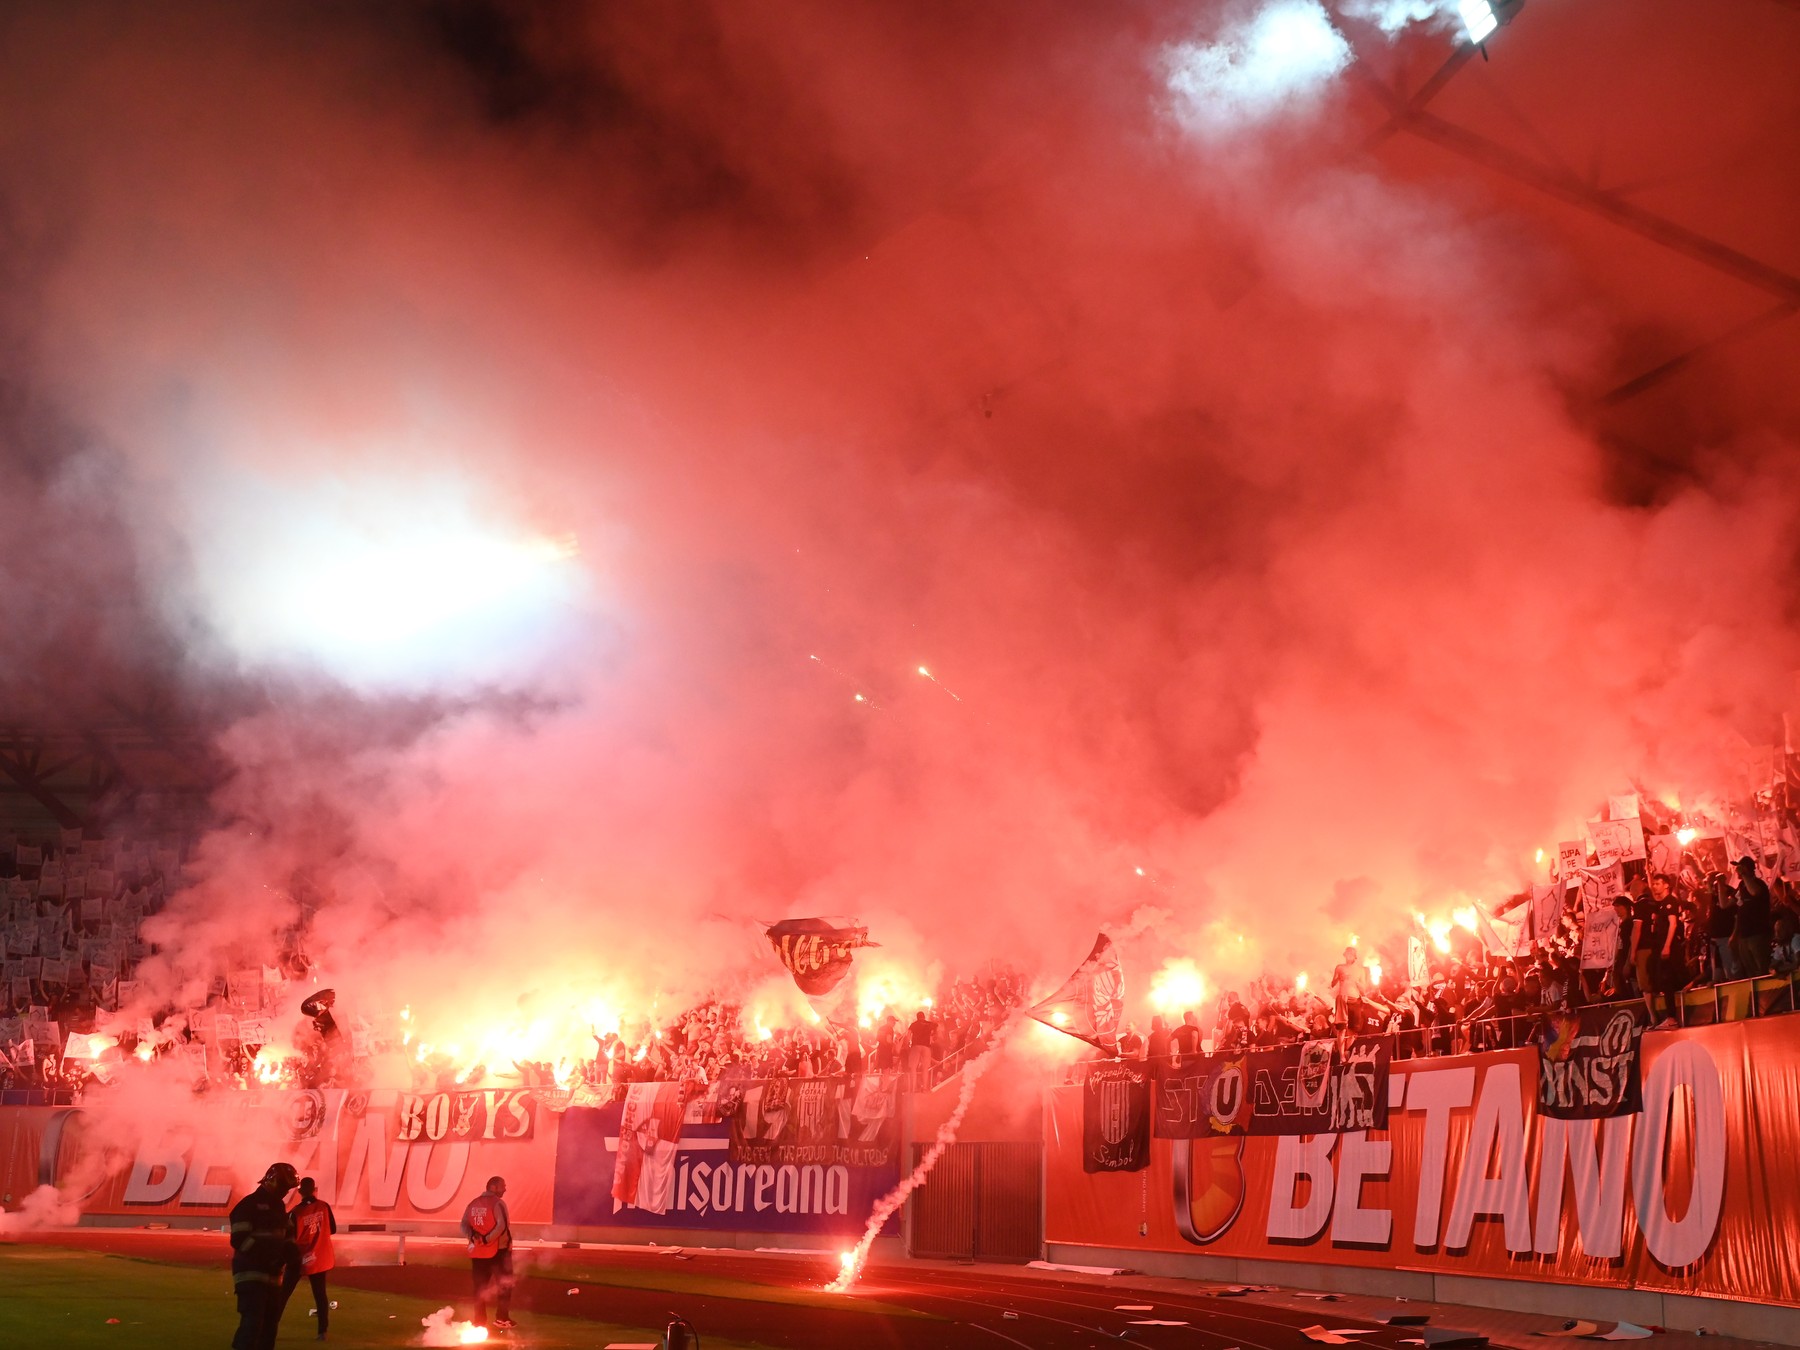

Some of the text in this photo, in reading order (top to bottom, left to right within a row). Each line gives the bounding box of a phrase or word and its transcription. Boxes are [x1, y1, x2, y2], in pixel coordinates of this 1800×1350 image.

[1560, 848, 1581, 860] CUPA
[1566, 859, 1576, 869] PE
[1599, 871, 1617, 885] CUPA
[1607, 884, 1616, 895] PE
[396, 1090, 530, 1140] BOYS
[1093, 1140, 1134, 1168] Simbol
